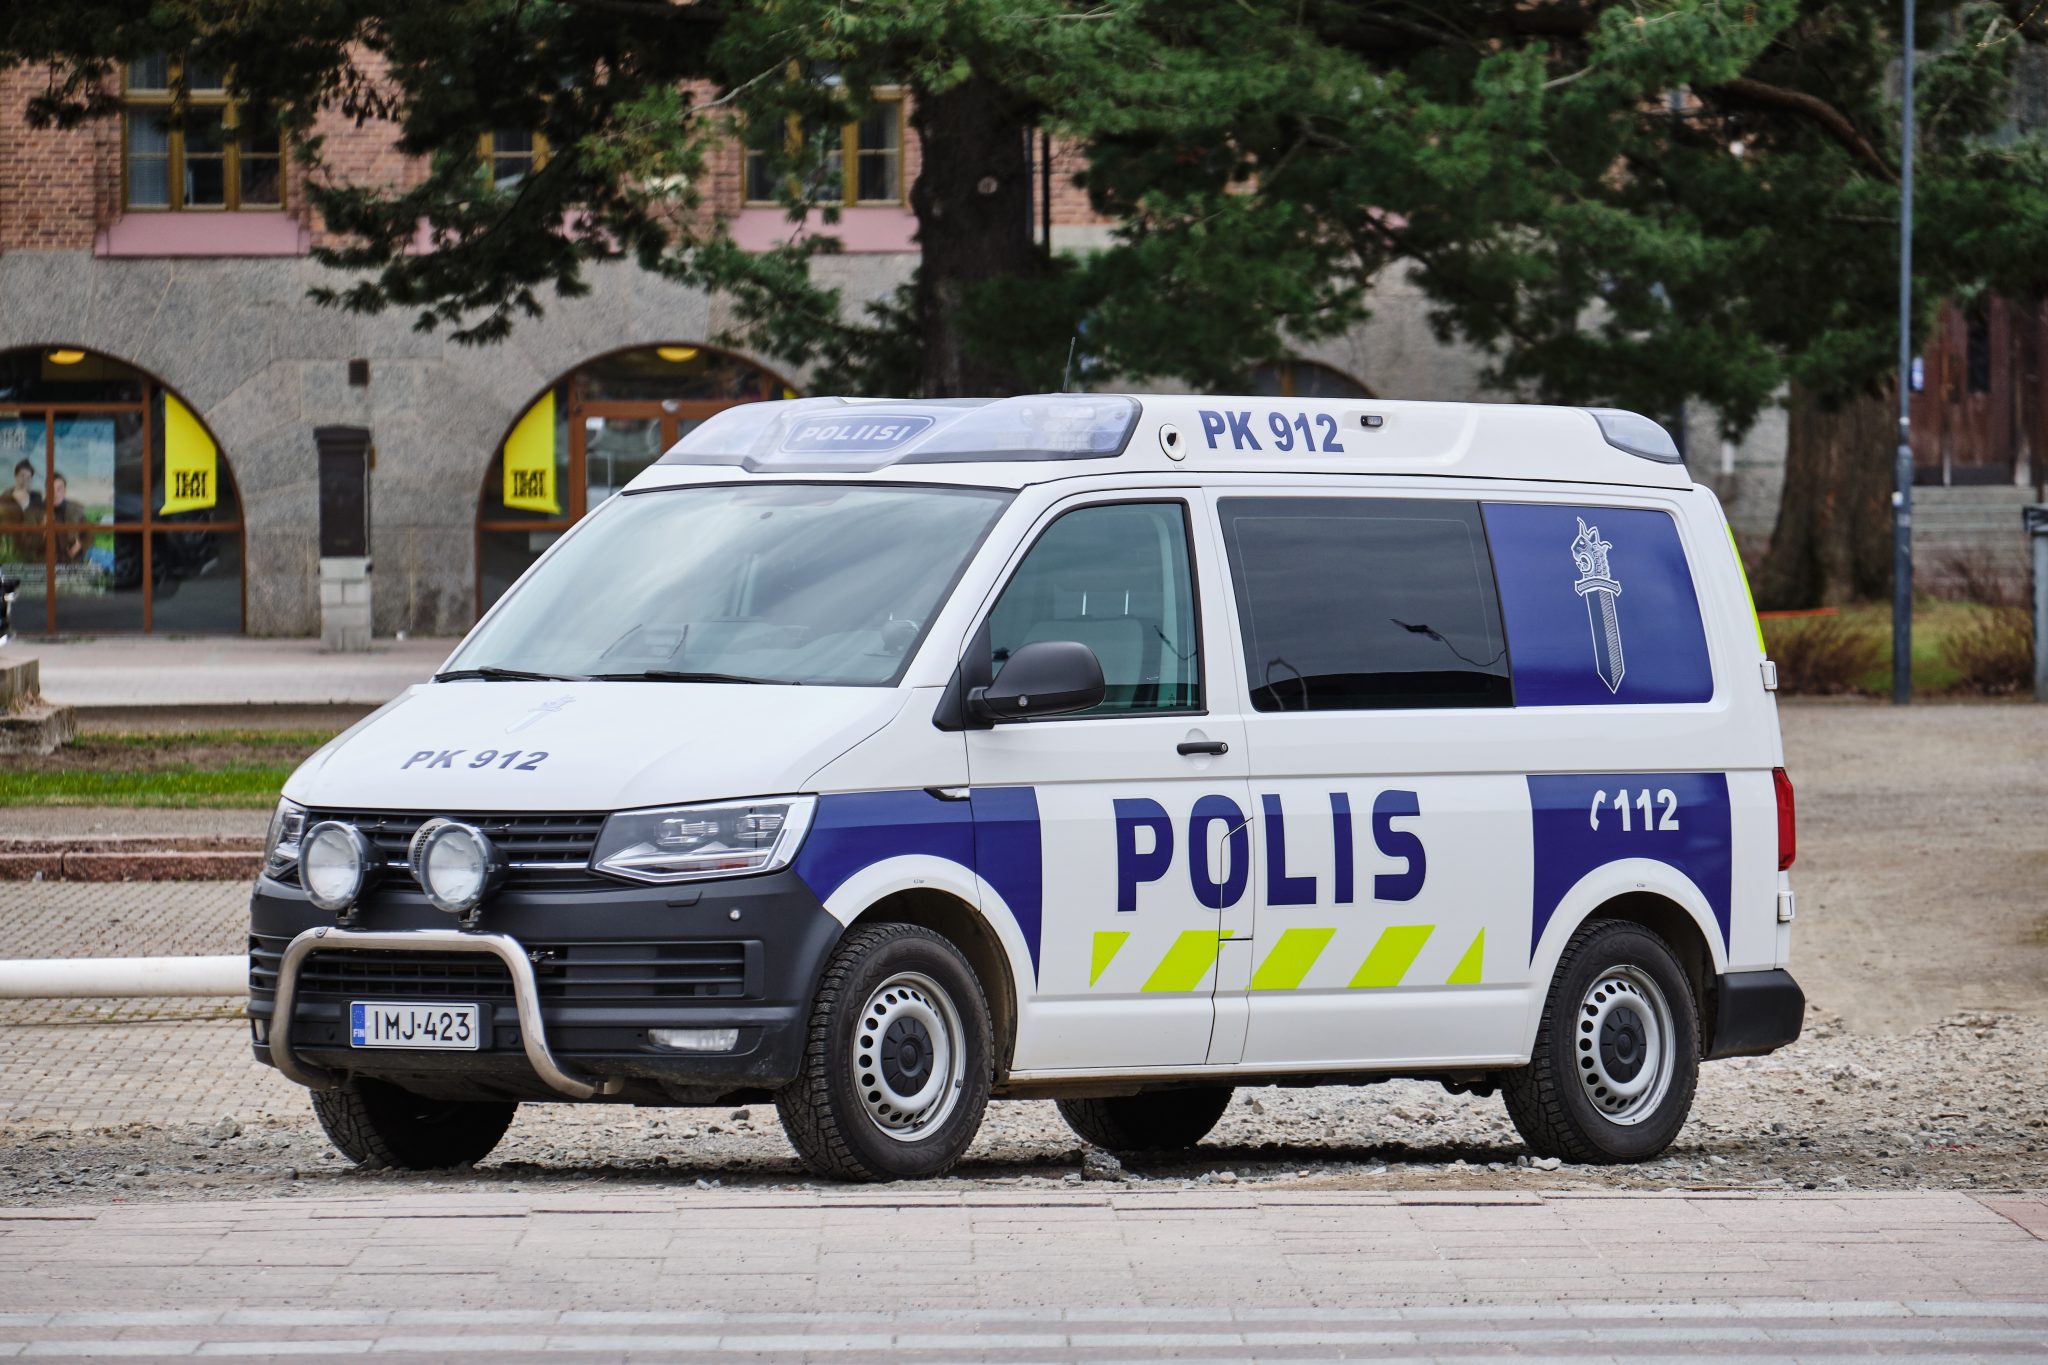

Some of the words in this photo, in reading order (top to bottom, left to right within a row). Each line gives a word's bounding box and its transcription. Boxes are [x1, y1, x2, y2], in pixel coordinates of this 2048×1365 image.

[795, 425, 912, 442] POLIISI
[1198, 410, 1263, 450] PK
[1268, 411, 1345, 453] 912
[400, 750, 468, 770] PK
[468, 749, 549, 771] 912
[1613, 788, 1680, 832] 112
[1112, 789, 1427, 913] POLIS
[353, 1028, 366, 1038] FIN
[374, 1010, 471, 1042] IMJ-423
